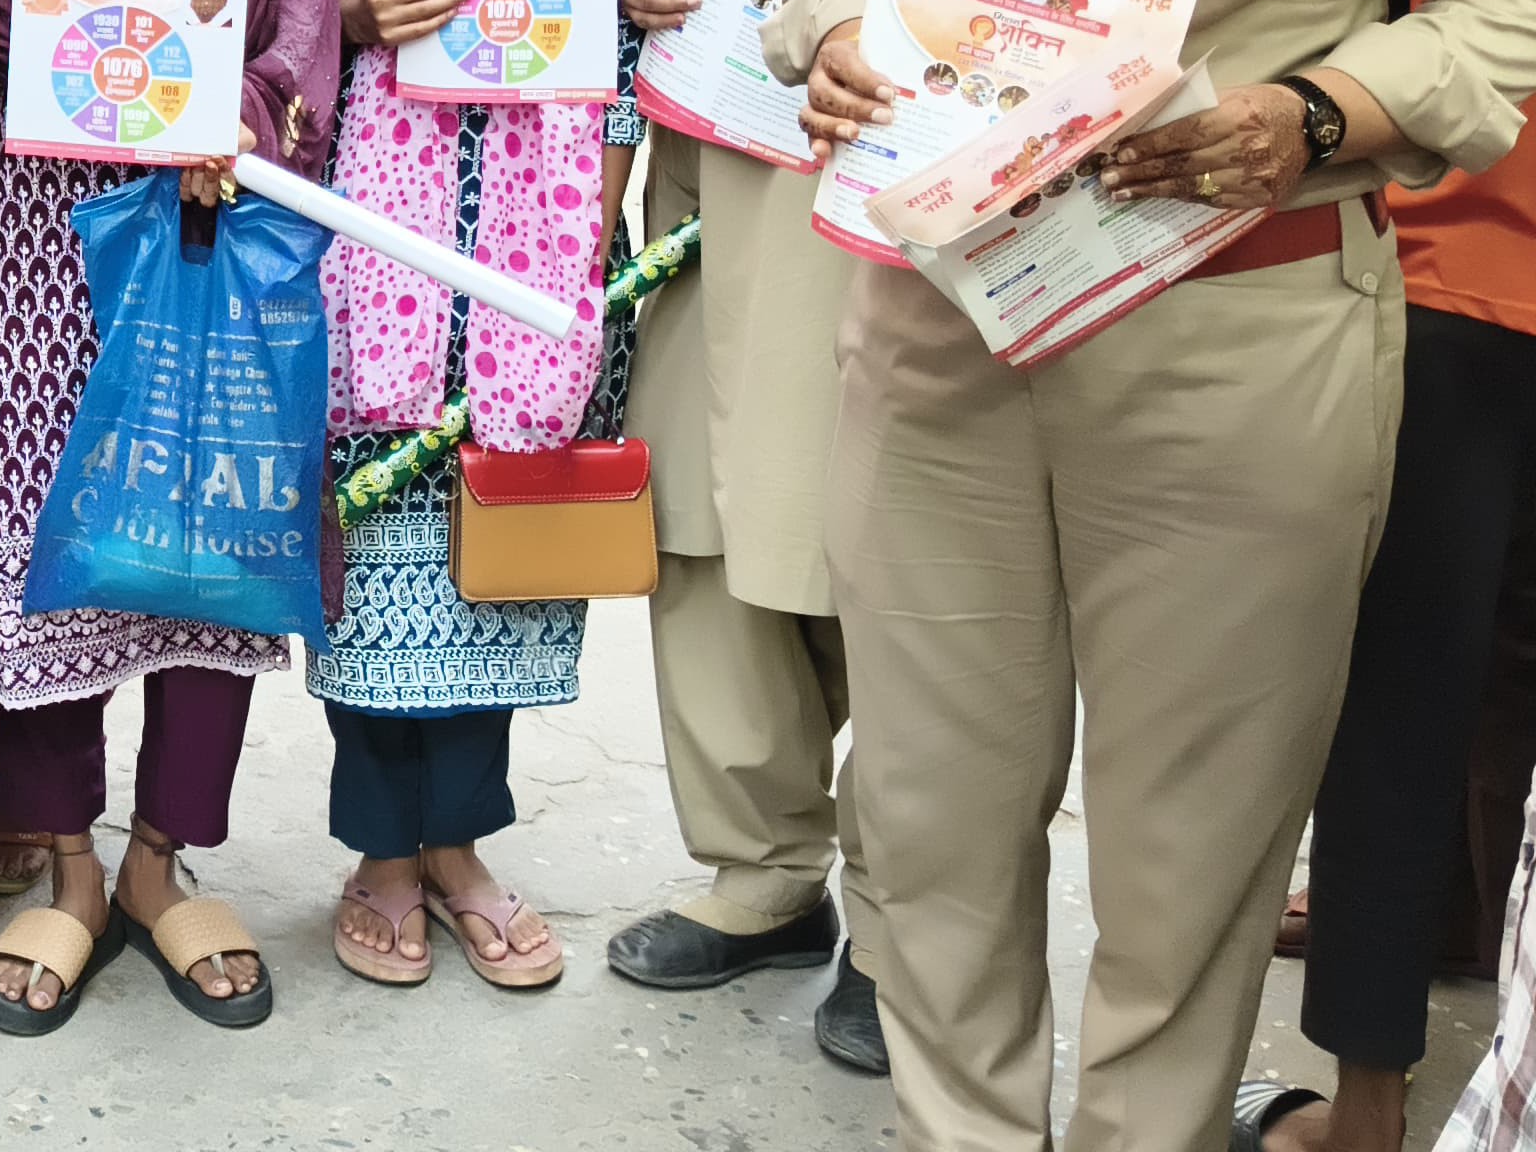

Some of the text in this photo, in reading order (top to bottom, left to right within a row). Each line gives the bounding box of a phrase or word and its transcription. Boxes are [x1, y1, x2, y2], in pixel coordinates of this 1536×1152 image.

[485, 0, 525, 20] 1076
[102, 56, 143, 79] 1076
[160, 85, 180, 97] 108
[904, 177, 953, 209] सशक्त
[921, 191, 954, 214] नारी
